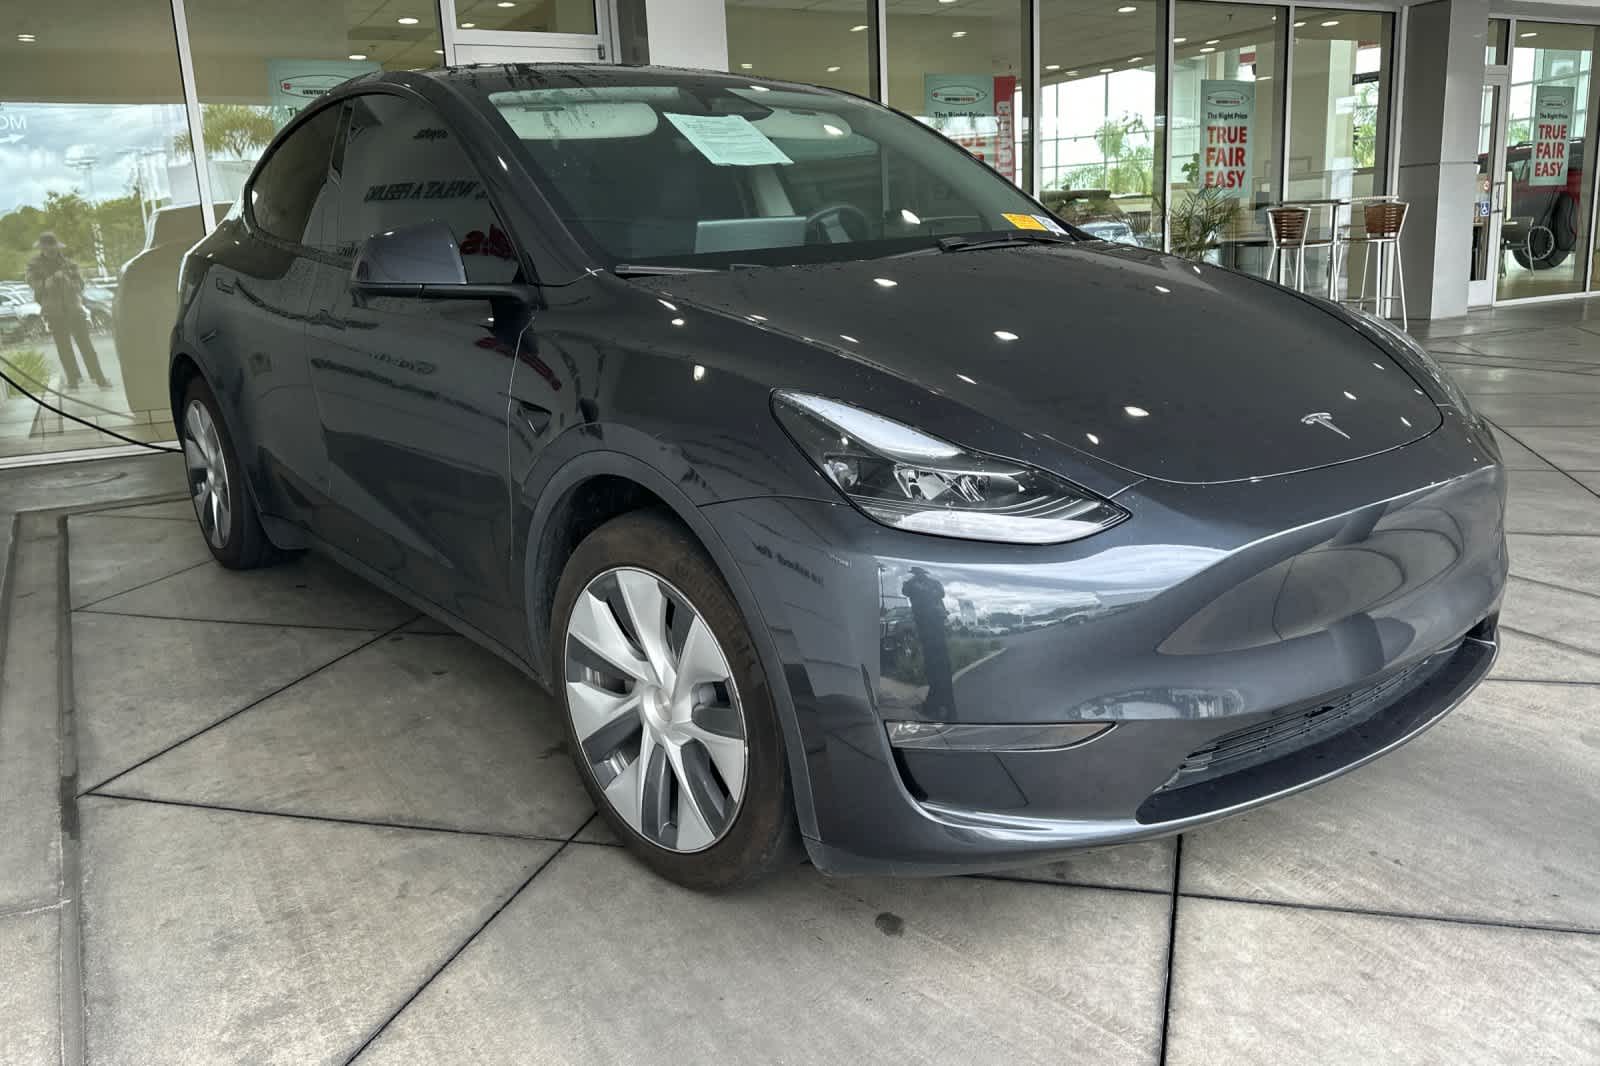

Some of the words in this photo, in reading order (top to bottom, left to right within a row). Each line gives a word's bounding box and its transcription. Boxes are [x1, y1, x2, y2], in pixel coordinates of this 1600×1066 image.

[1218, 112, 1234, 120] Right
[1207, 125, 1248, 144] TRUE
[1538, 124, 1567, 140] TRUE
[1206, 147, 1246, 167] FAIR
[1536, 142, 1565, 159] FAIR
[1534, 162, 1564, 177] EASY
[1205, 170, 1246, 189] EASY
